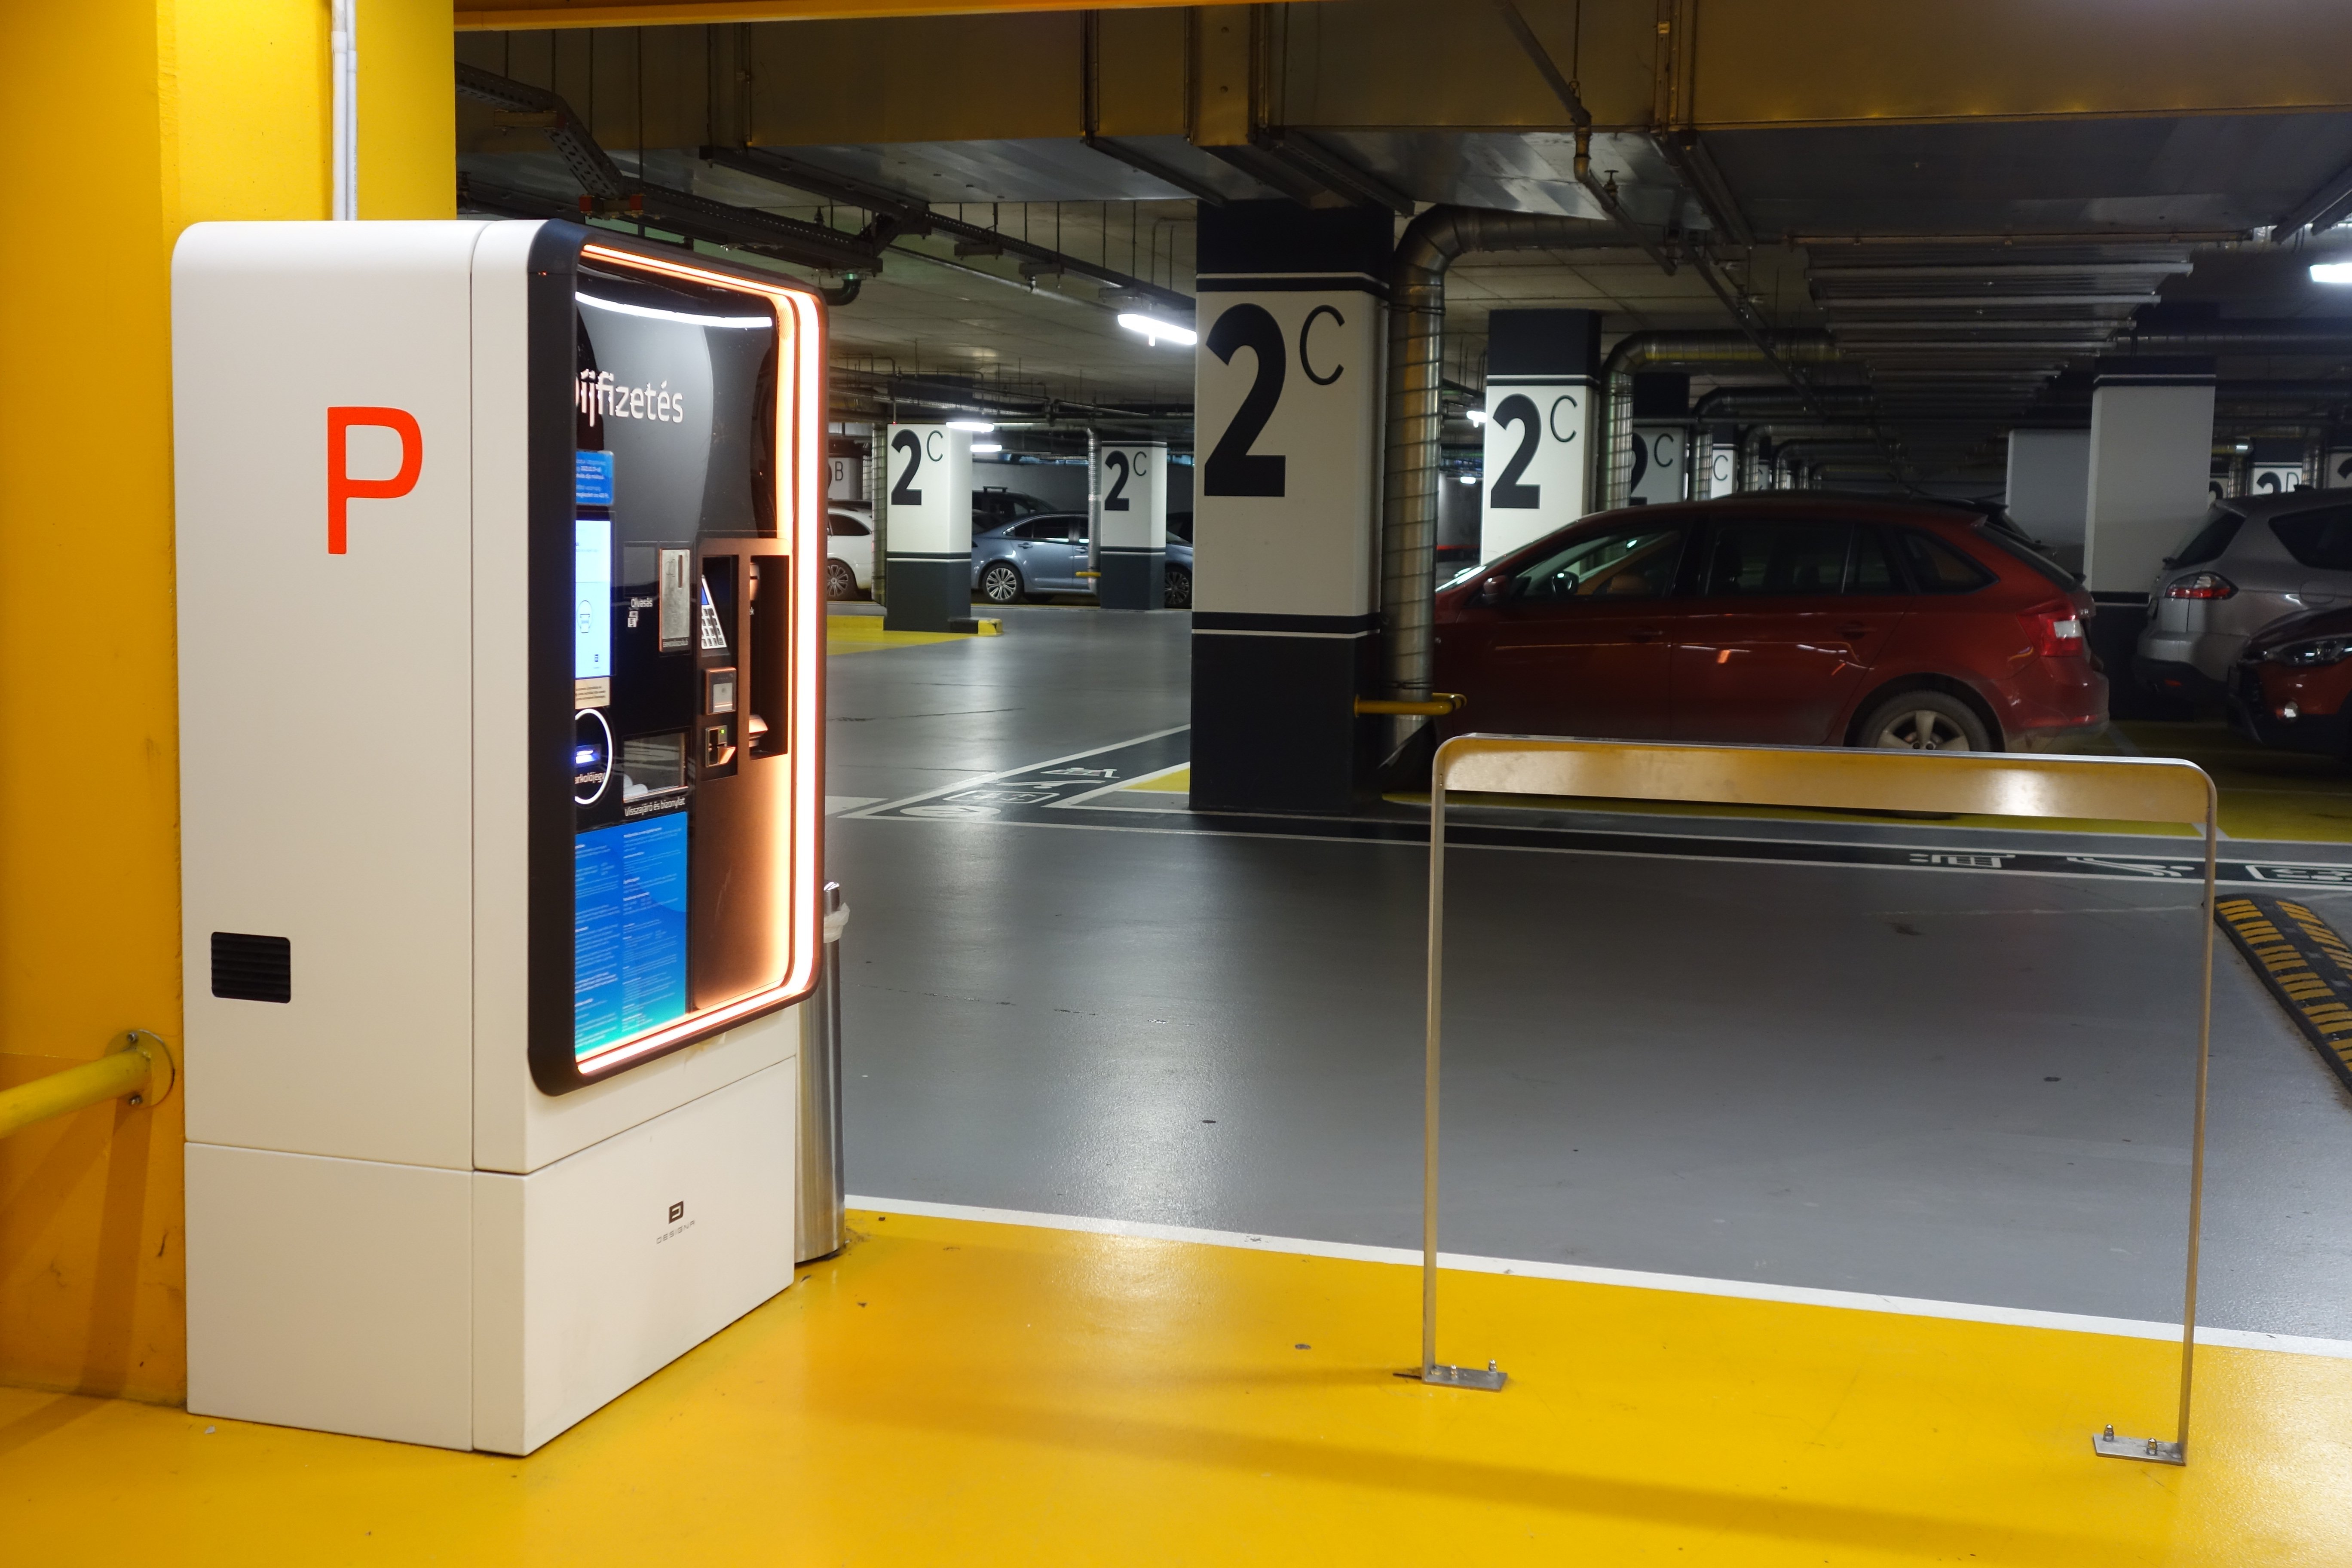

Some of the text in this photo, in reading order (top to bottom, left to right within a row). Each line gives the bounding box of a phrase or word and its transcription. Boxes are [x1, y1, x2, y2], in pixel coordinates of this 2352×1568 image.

[575, 368, 683, 427] íjfizetés
[327, 406, 423, 555] P
[1713, 454, 1728, 481] C
[575, 772, 606, 784] arkolójegy
[653, 801, 660, 810] és
